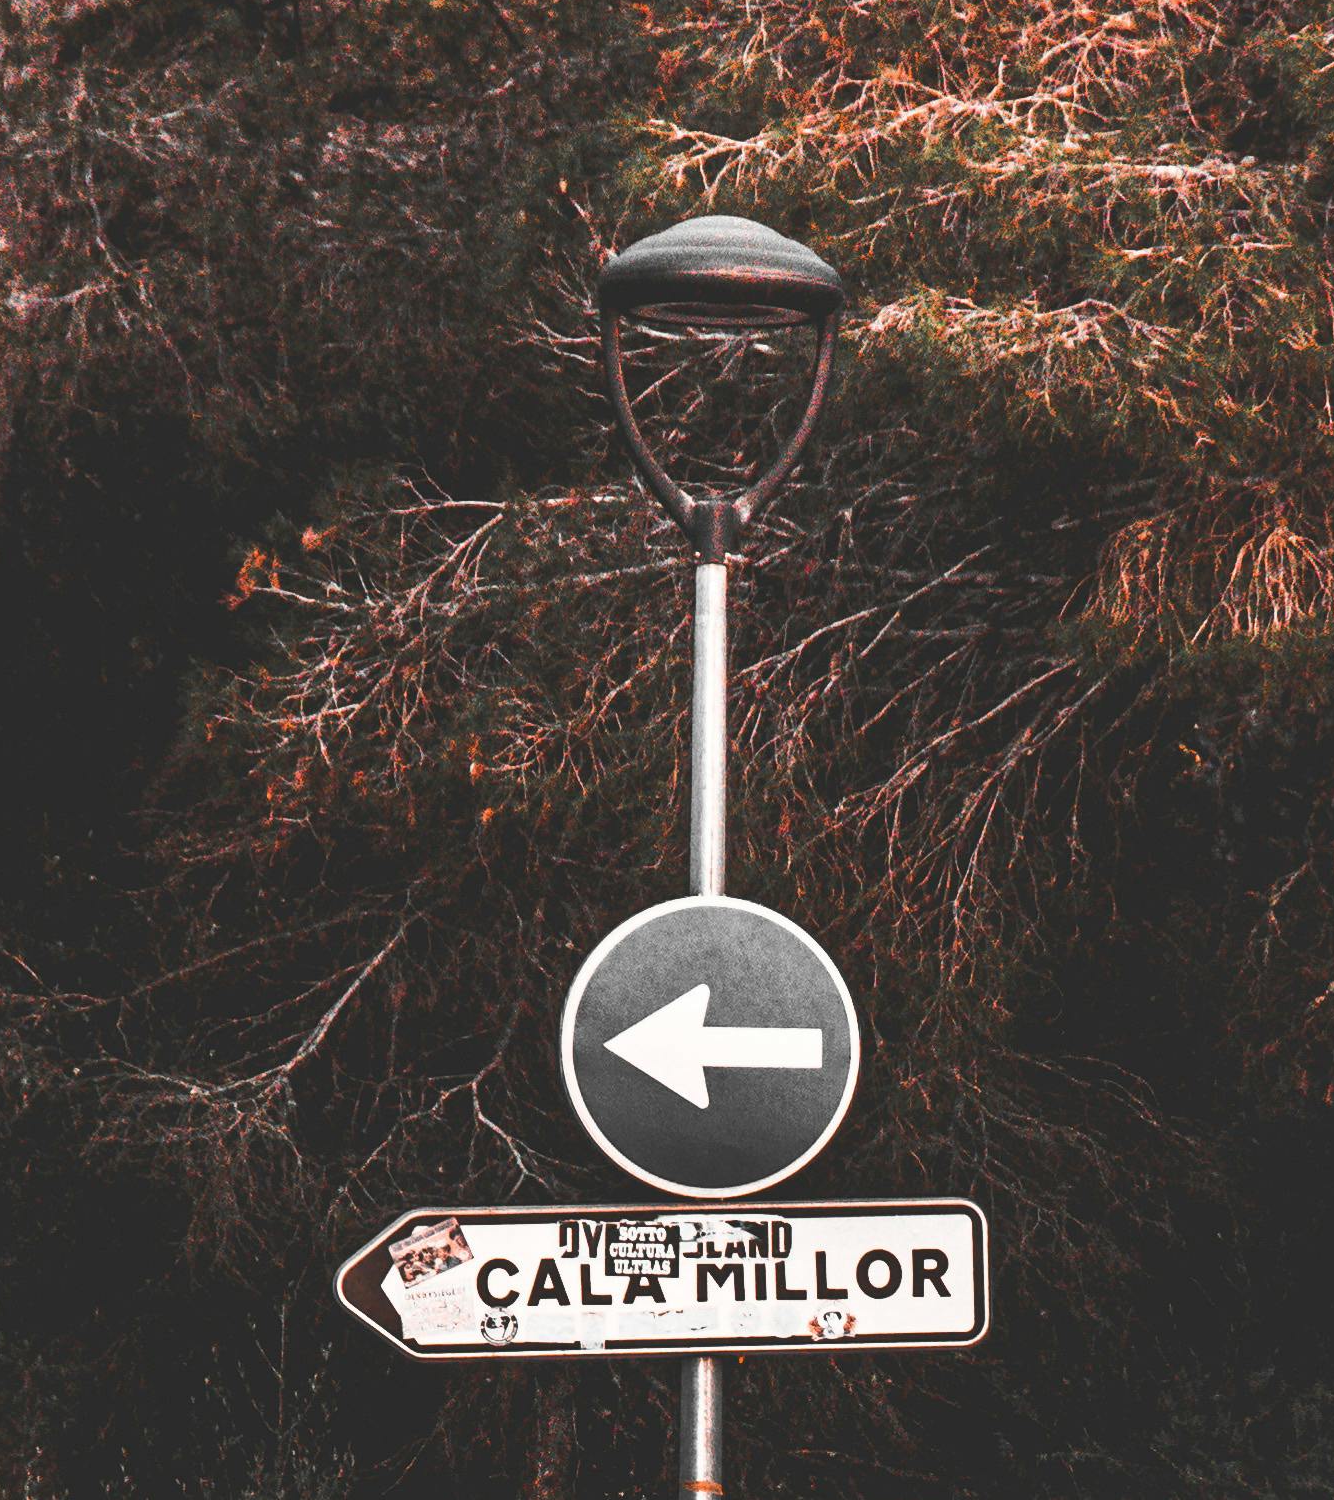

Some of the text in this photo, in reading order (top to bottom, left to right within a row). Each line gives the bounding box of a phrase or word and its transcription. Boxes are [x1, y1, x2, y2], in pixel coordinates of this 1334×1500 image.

[618, 1226, 667, 1242] SOTTO
[609, 1242, 676, 1259] CULTURA
[613, 1259, 671, 1275] ULTRAS
[476, 1248, 952, 1308] CALA MILLOR
